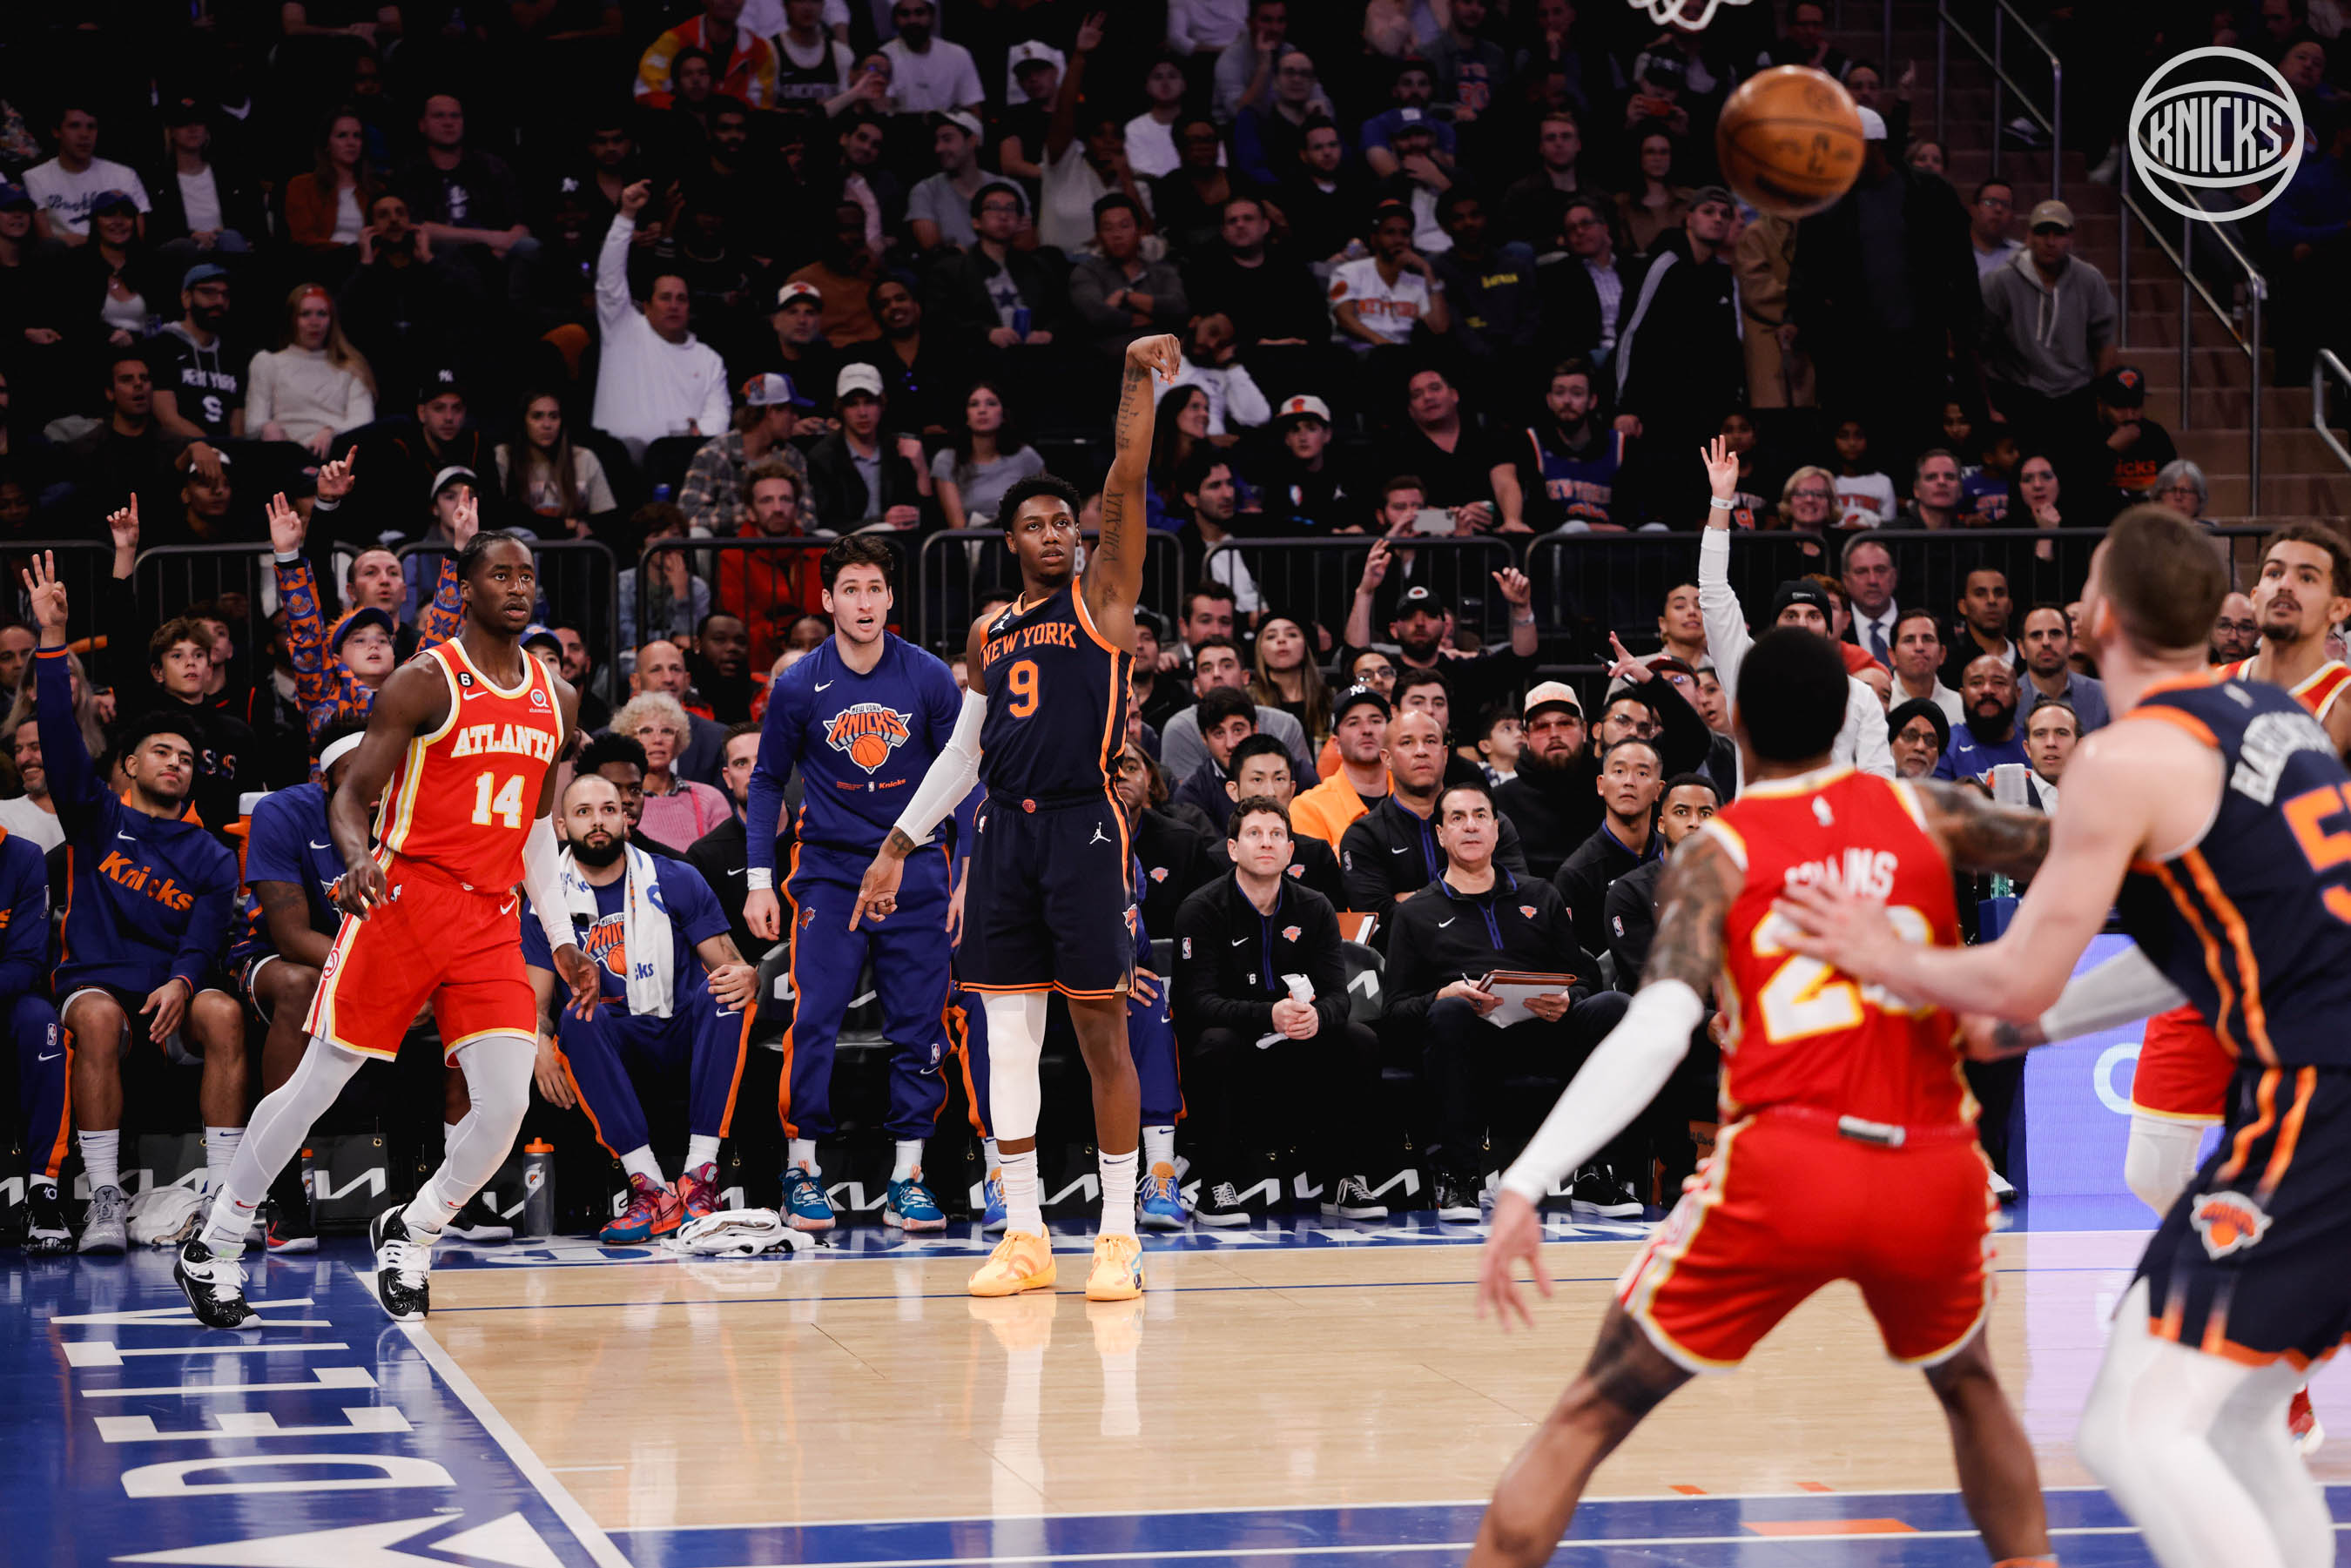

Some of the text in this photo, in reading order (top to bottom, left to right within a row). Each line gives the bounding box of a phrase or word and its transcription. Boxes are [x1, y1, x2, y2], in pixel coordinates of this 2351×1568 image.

[982, 621, 1078, 672] NEW YORK
[458, 672, 471, 687] 6
[1008, 658, 1039, 718] 9
[829, 710, 909, 743] KNICKS
[851, 705, 865, 714] NEW
[449, 723, 556, 766] ATLANTA
[471, 771, 526, 830] 14
[878, 778, 906, 791] Knicks
[98, 850, 195, 912] Knicks
[585, 920, 625, 954] KNIC
[50, 1297, 458, 1499] DELTA
